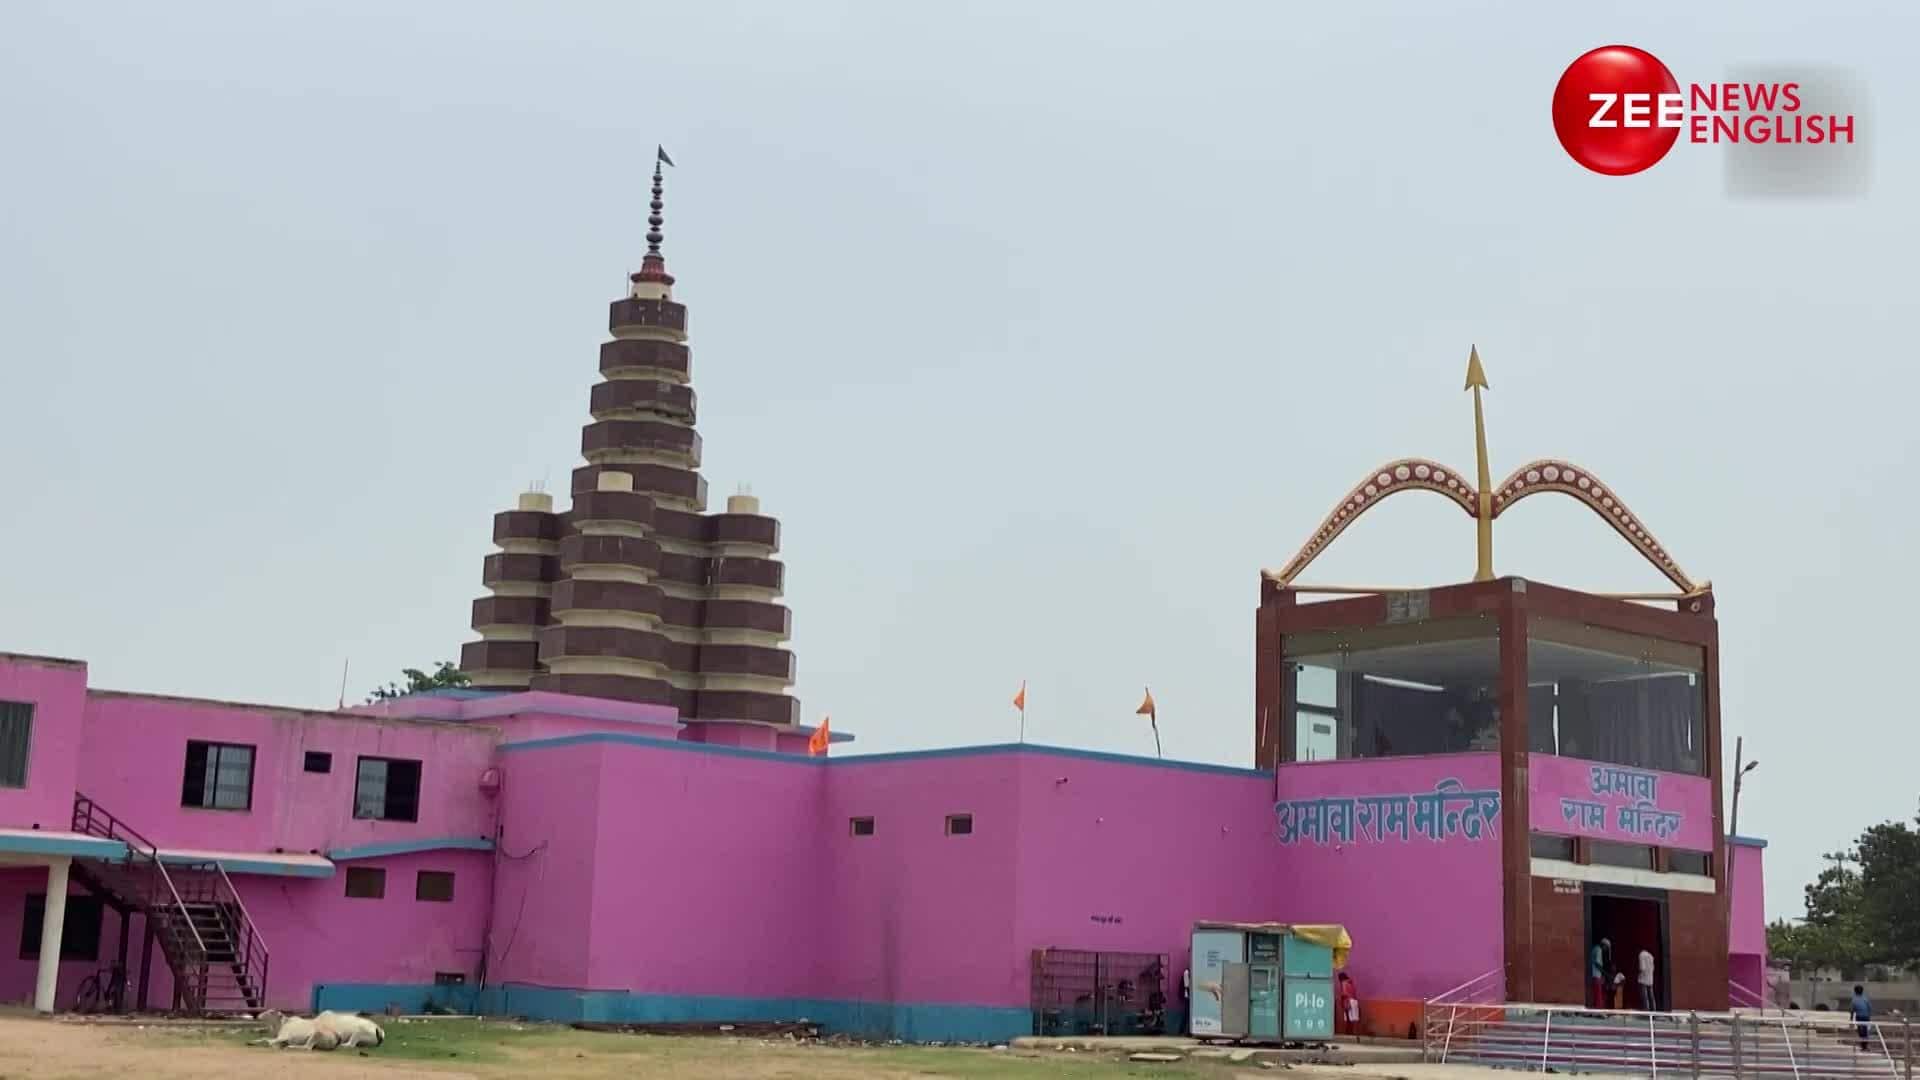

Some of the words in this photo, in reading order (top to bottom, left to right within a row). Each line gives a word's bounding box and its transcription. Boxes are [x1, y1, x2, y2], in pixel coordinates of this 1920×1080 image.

[1591, 764, 1659, 800] अमावा
[1275, 799, 1355, 844] अमावा
[1357, 795, 1410, 843] राम
[1411, 777, 1501, 842] मन्दिर
[1561, 798, 1607, 832] राम
[1617, 801, 1683, 839] मन्दिर
